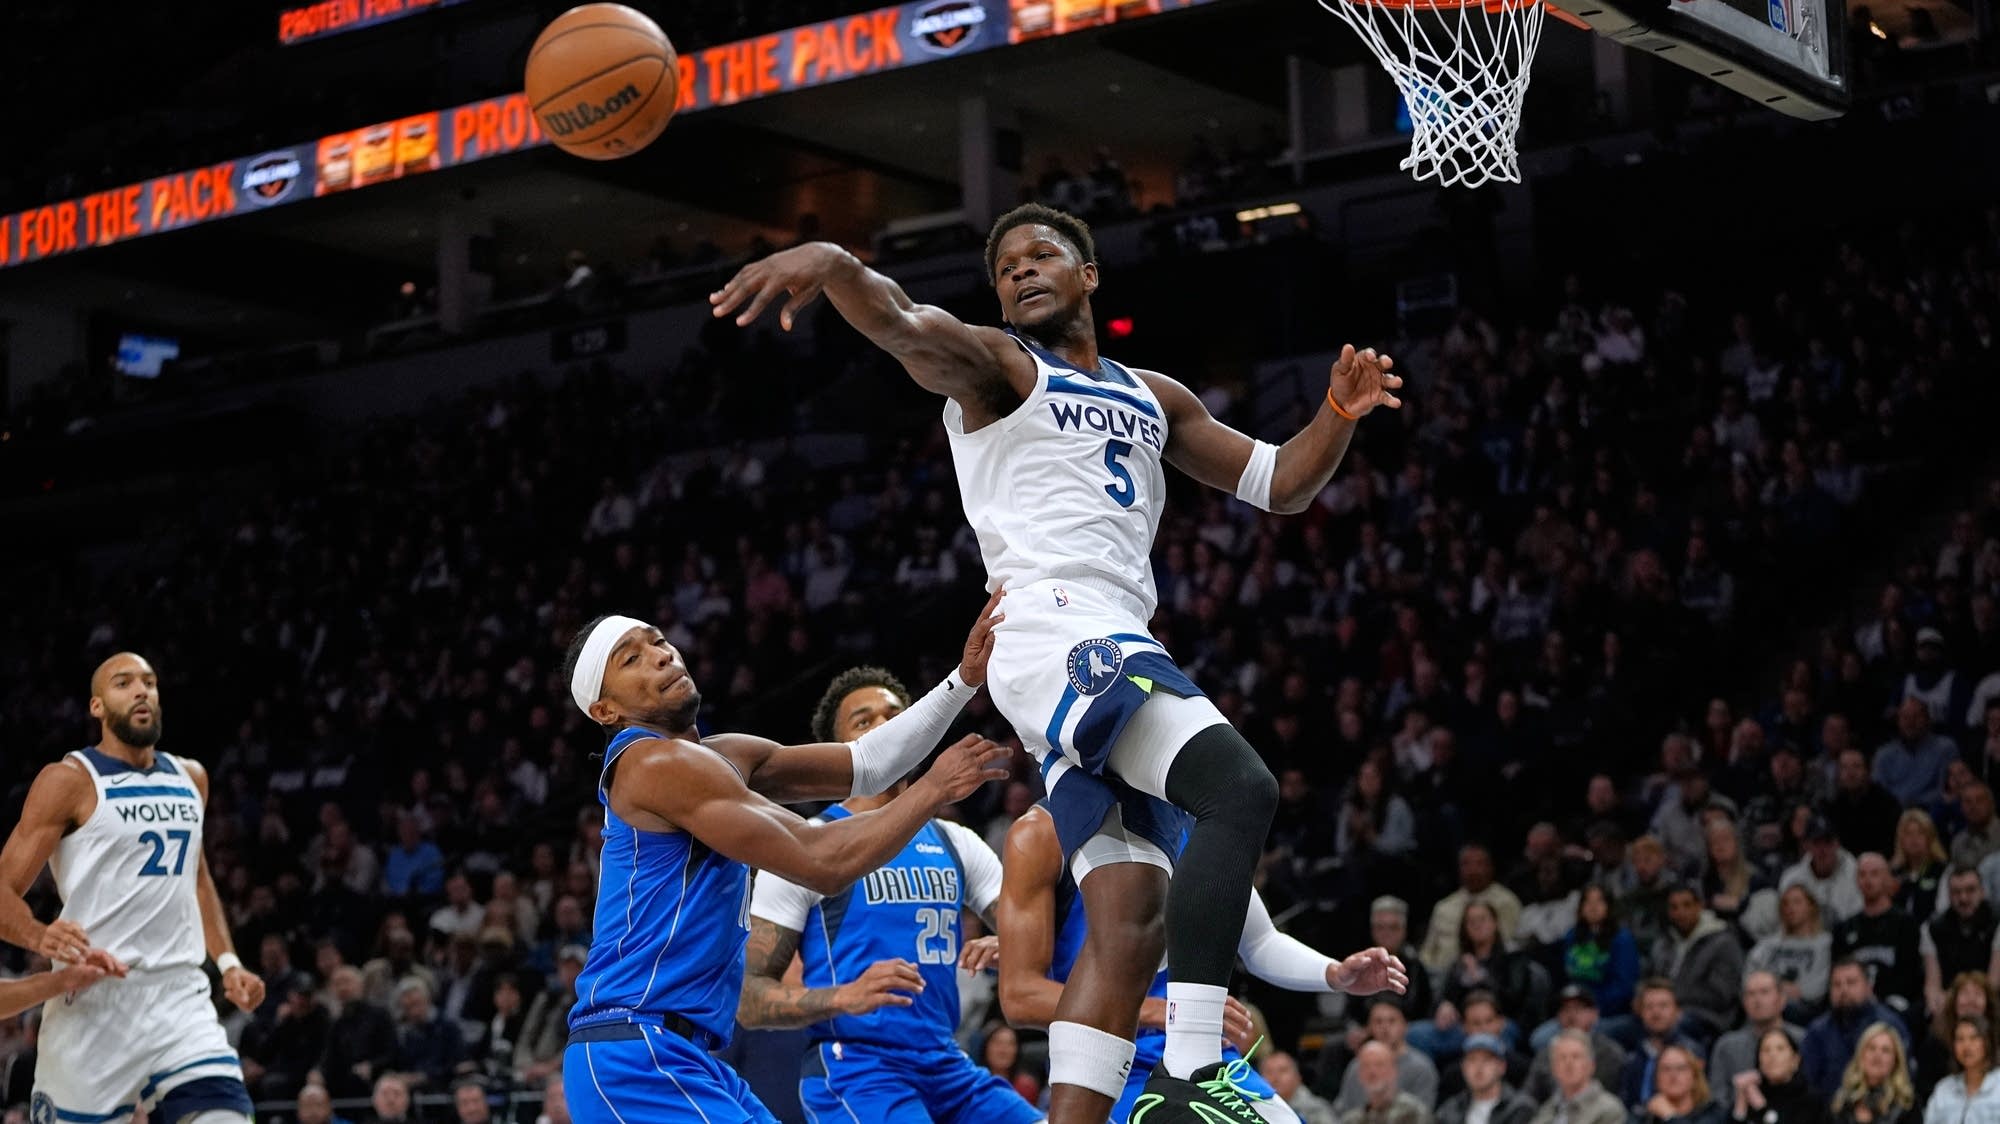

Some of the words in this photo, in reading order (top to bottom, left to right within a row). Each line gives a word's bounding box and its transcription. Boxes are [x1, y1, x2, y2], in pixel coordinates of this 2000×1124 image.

[704, 34, 781, 104] THE
[788, 9, 902, 84] PACK
[545, 84, 641, 136] Wilson
[19, 203, 77, 261] FOR
[82, 184, 143, 245] THE
[151, 161, 237, 230] PACK
[1049, 402, 1161, 452] WOLVES
[1104, 438, 1135, 508] 5
[1068, 652, 1087, 694] MINNESOTA
[1077, 639, 1121, 664] TIMBERWOLVES
[116, 803, 199, 823] WOLVES
[138, 829, 191, 876] 27
[863, 867, 959, 905] DALLAS
[915, 908, 958, 965] 25
